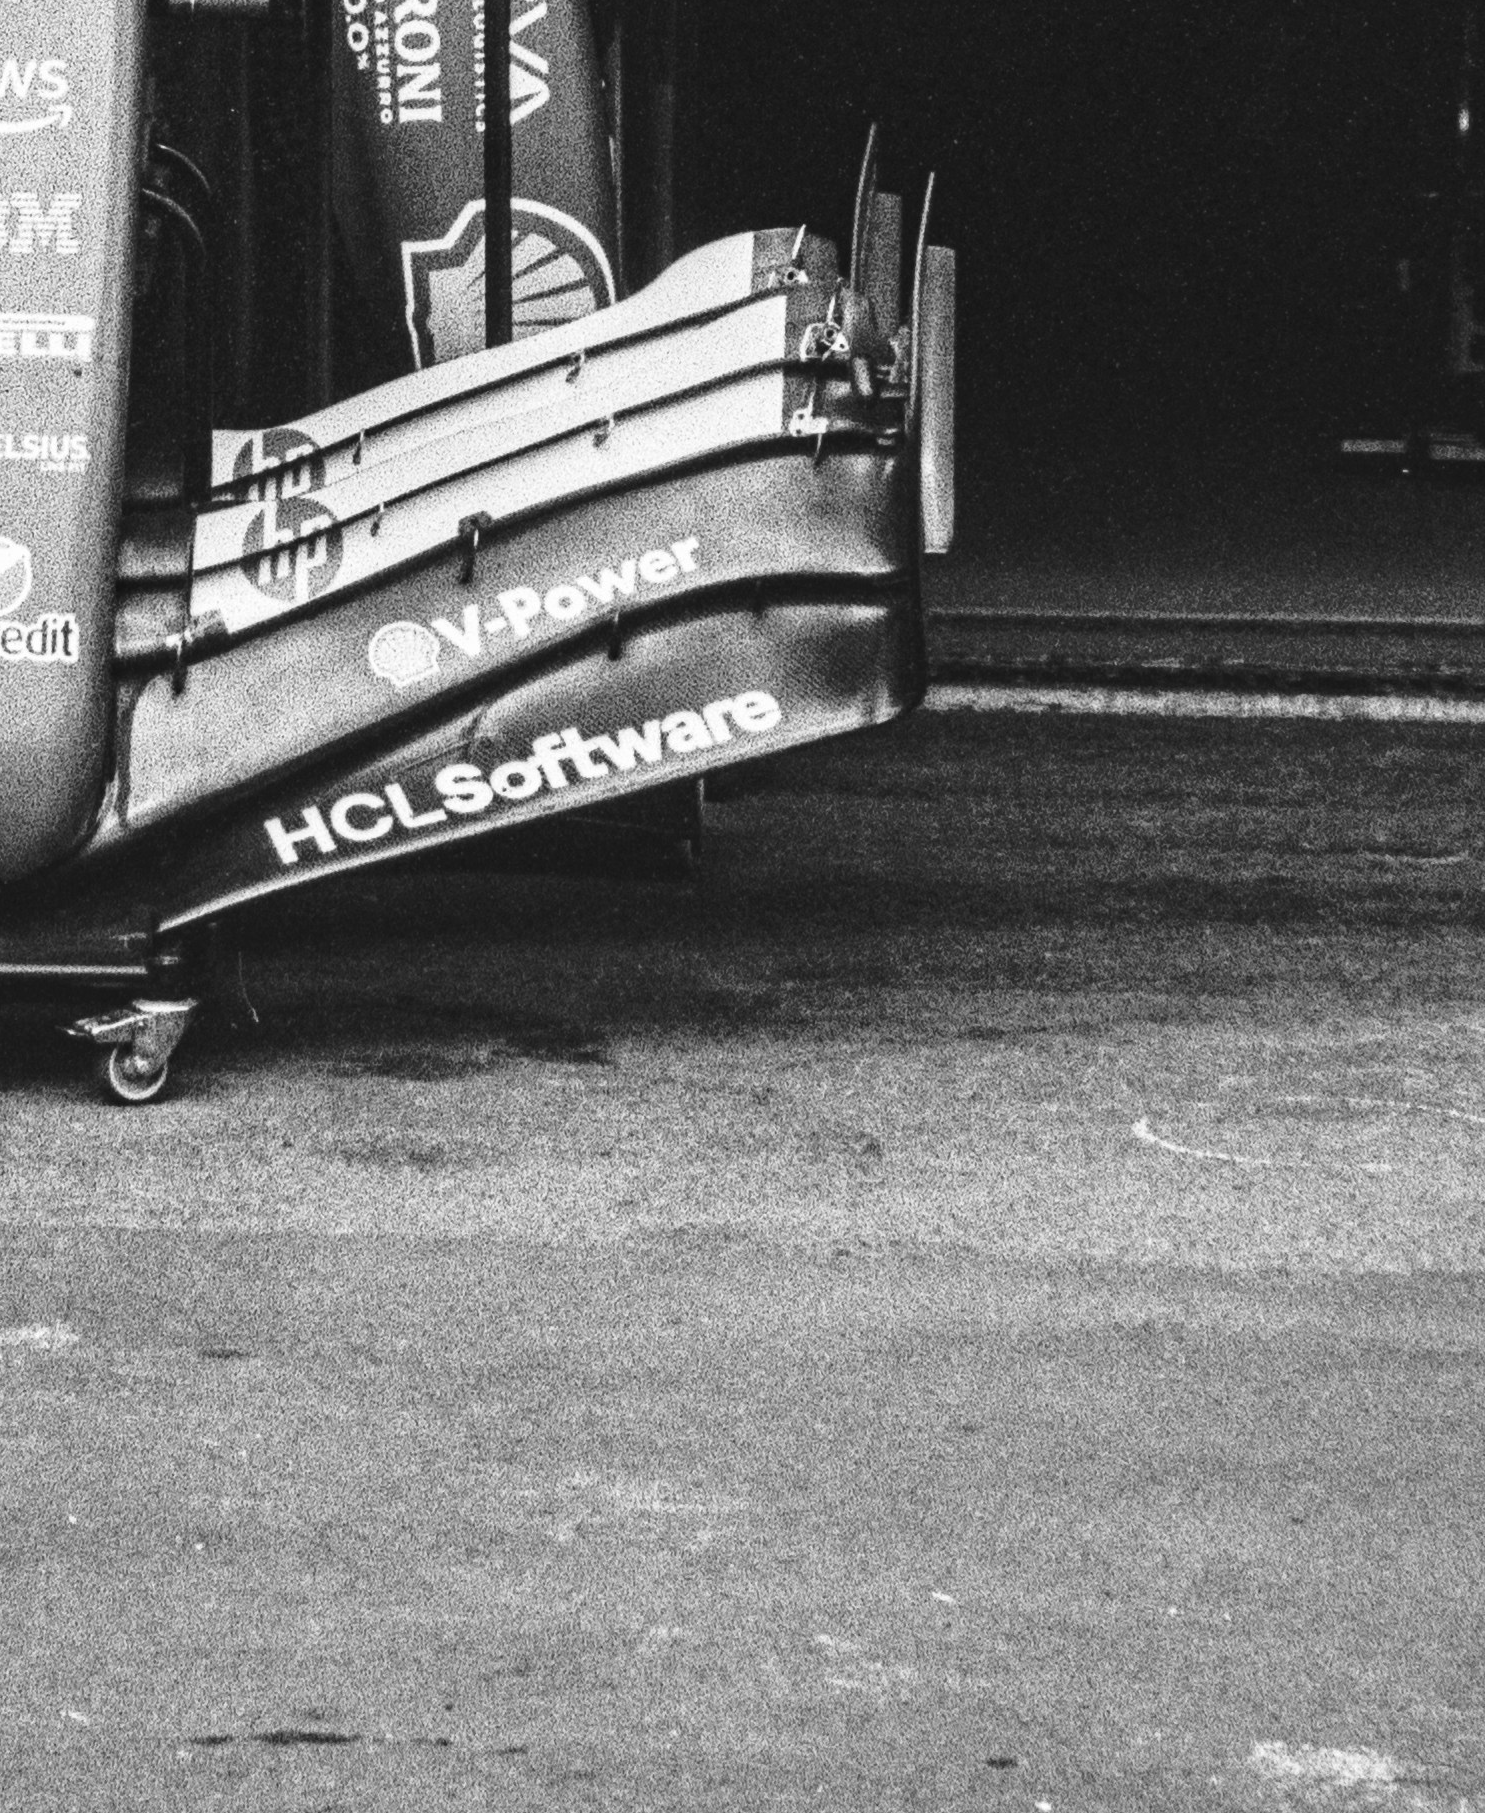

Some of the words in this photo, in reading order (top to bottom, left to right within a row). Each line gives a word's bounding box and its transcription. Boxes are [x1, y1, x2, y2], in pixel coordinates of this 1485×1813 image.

[375, 10, 393, 125] AZZURRO
[432, 534, 701, 658] V-Power
[263, 689, 782, 865] HCLSoftware
